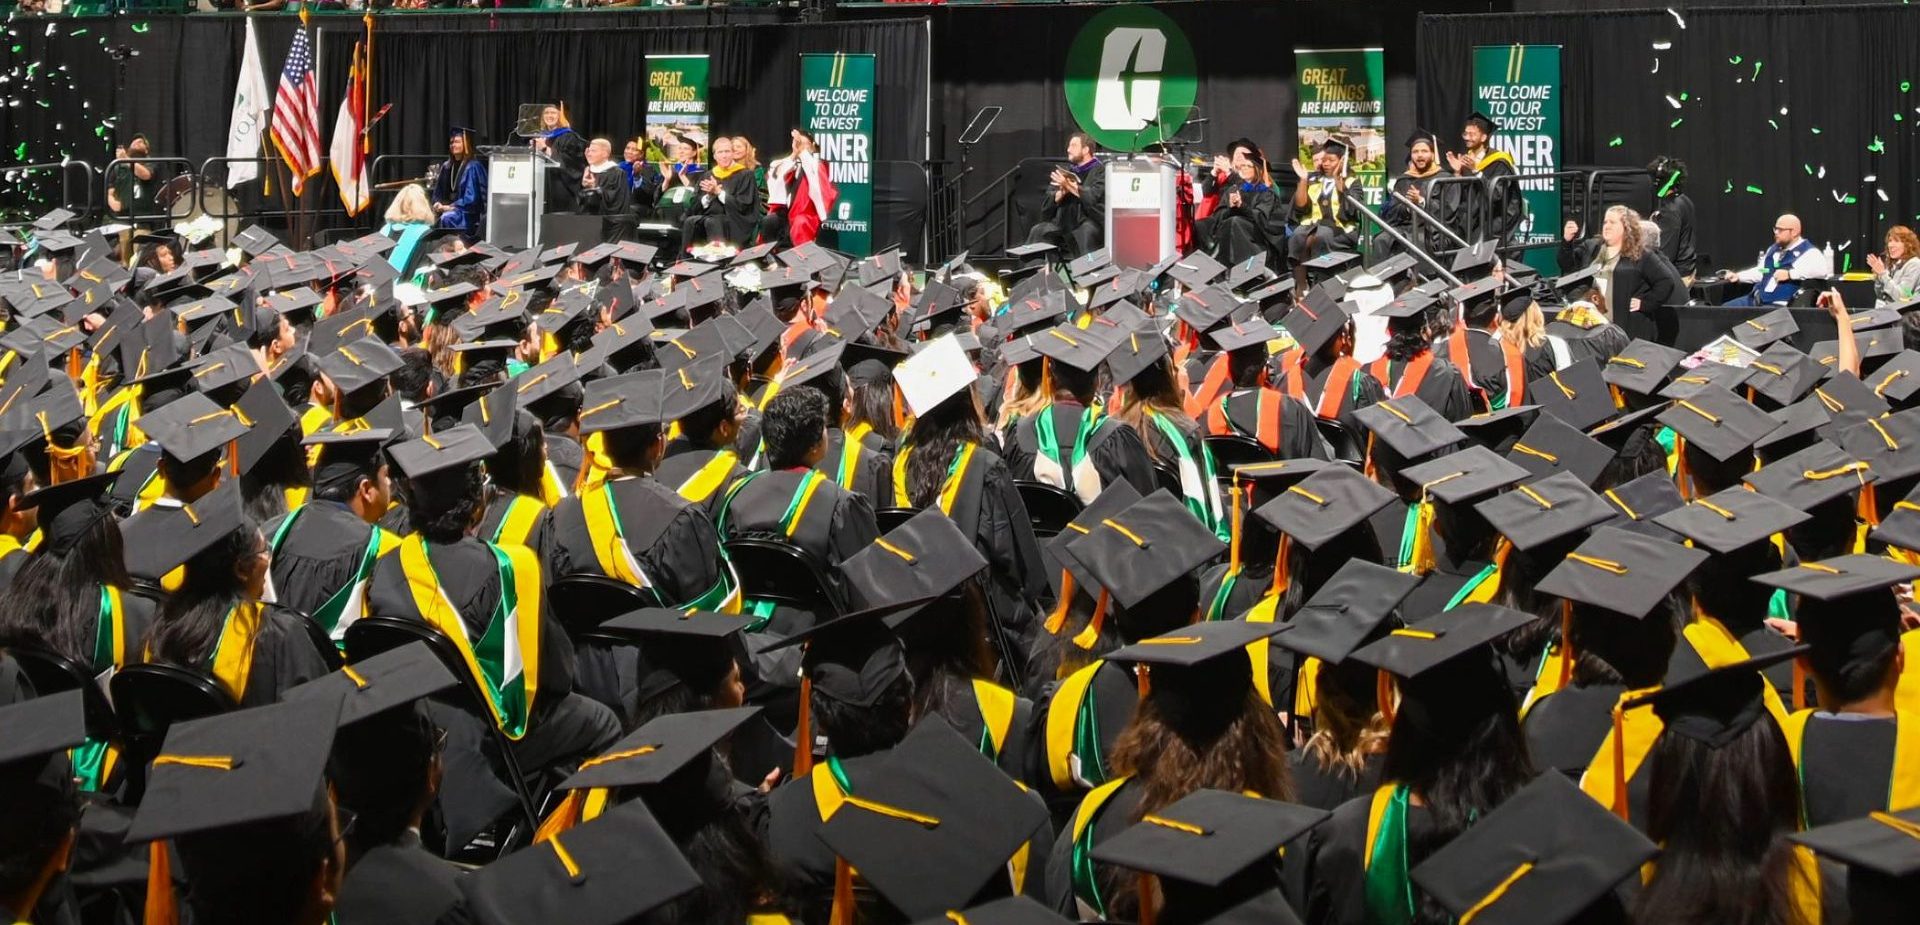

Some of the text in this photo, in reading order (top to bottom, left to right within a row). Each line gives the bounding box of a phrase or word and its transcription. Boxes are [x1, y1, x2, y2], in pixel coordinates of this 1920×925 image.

[649, 71, 682, 87] GREAT
[1302, 68, 1347, 85] GREAT
[658, 86, 696, 101] THINGS
[806, 89, 868, 102] WELCOME
[1315, 84, 1366, 101] THINGS
[1479, 85, 1552, 100] WELCOME
[648, 101, 706, 112] ARE HAPPENING
[814, 103, 859, 116] TO OUR
[1300, 100, 1382, 114] ARE HAPPENING
[1488, 101, 1542, 115] TO OUR
[810, 117, 862, 130] NEWEST
[1492, 117, 1546, 131] EWEST
[814, 133, 868, 162] INER
[1515, 167, 1554, 191] MNI!
